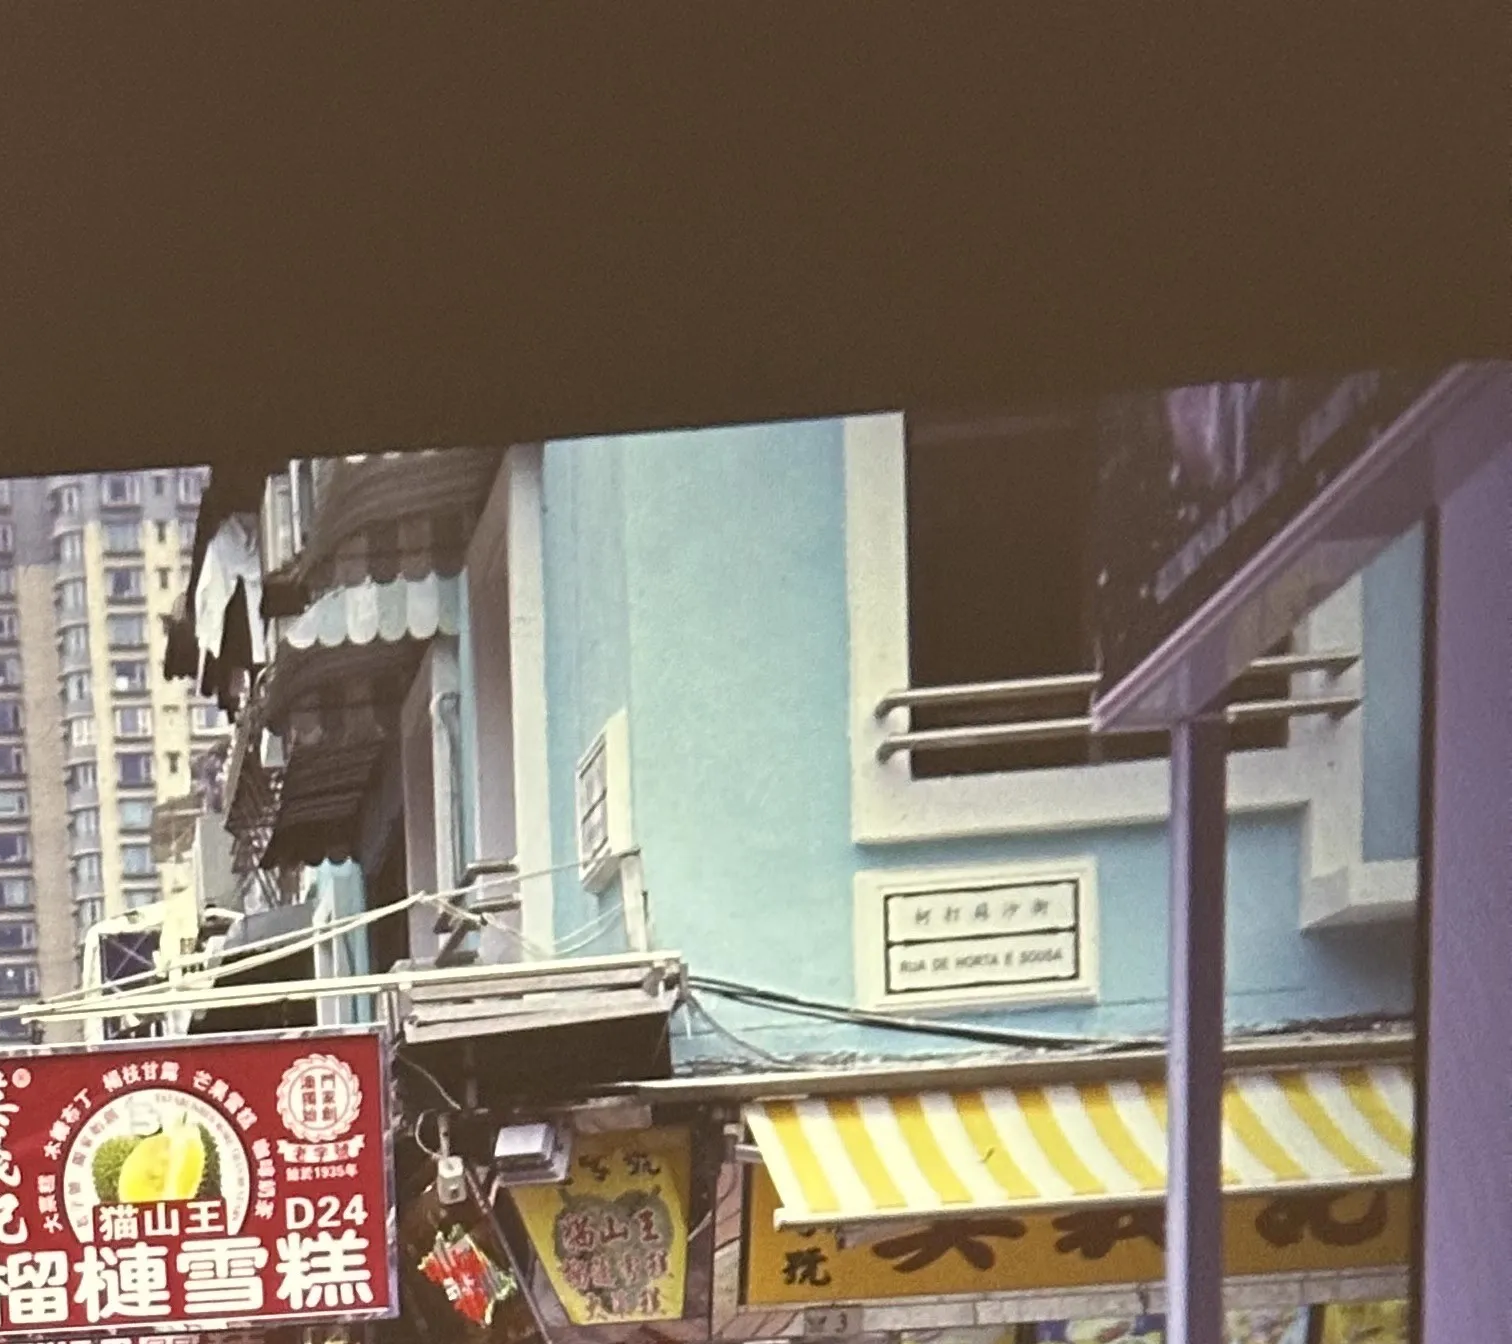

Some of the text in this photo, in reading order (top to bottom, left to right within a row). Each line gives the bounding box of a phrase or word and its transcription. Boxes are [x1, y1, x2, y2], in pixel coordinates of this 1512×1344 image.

[900, 959, 926, 973] RUA
[932, 957, 949, 971] DE
[1004, 951, 1013, 966] E
[285, 1193, 369, 1230] D24
